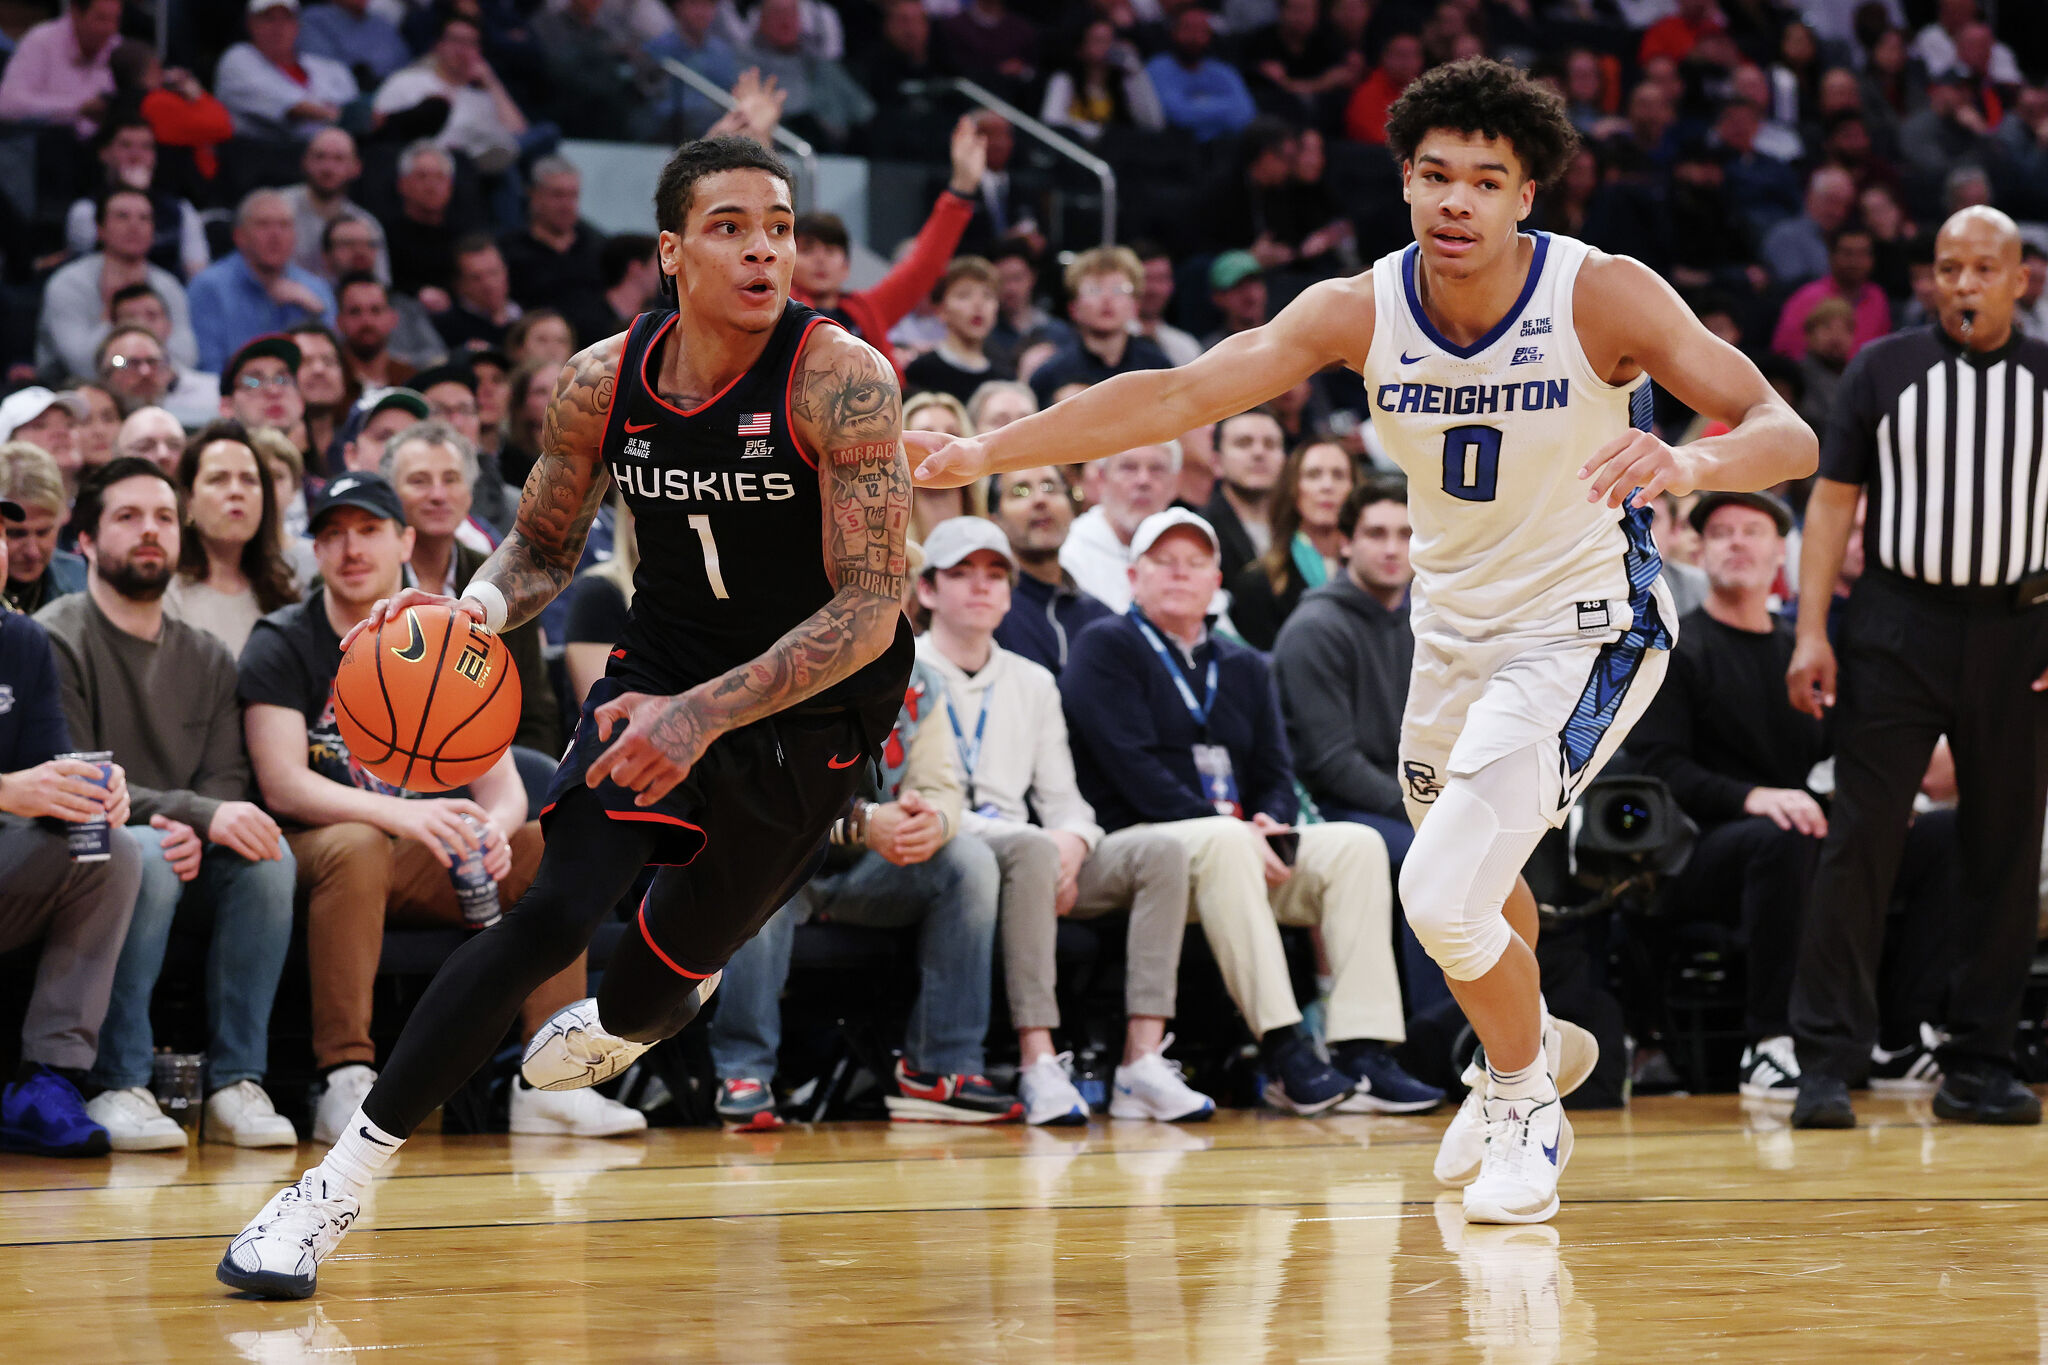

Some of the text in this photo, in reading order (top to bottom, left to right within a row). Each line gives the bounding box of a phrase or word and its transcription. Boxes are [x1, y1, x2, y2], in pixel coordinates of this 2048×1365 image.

[1522, 317, 1551, 329] BE THE
[1520, 325, 1553, 337] CHANGE
[1511, 353, 1544, 363] EAST
[1515, 346, 1539, 355] BIG
[1376, 378, 1569, 415] CREIGHTON
[628, 437, 652, 450] BE THE
[743, 446, 775, 456] EAST
[746, 439, 767, 448] BIG
[623, 445, 651, 459] CHANGE
[833, 442, 897, 466] EMBRAC
[1440, 424, 1503, 502] 0
[612, 462, 796, 502] HUSKIES
[865, 483, 881, 498] 12
[864, 505, 886, 520] THE
[687, 514, 730, 600] 1
[841, 569, 904, 600] JOURNE
[454, 621, 493, 684] ELIT
